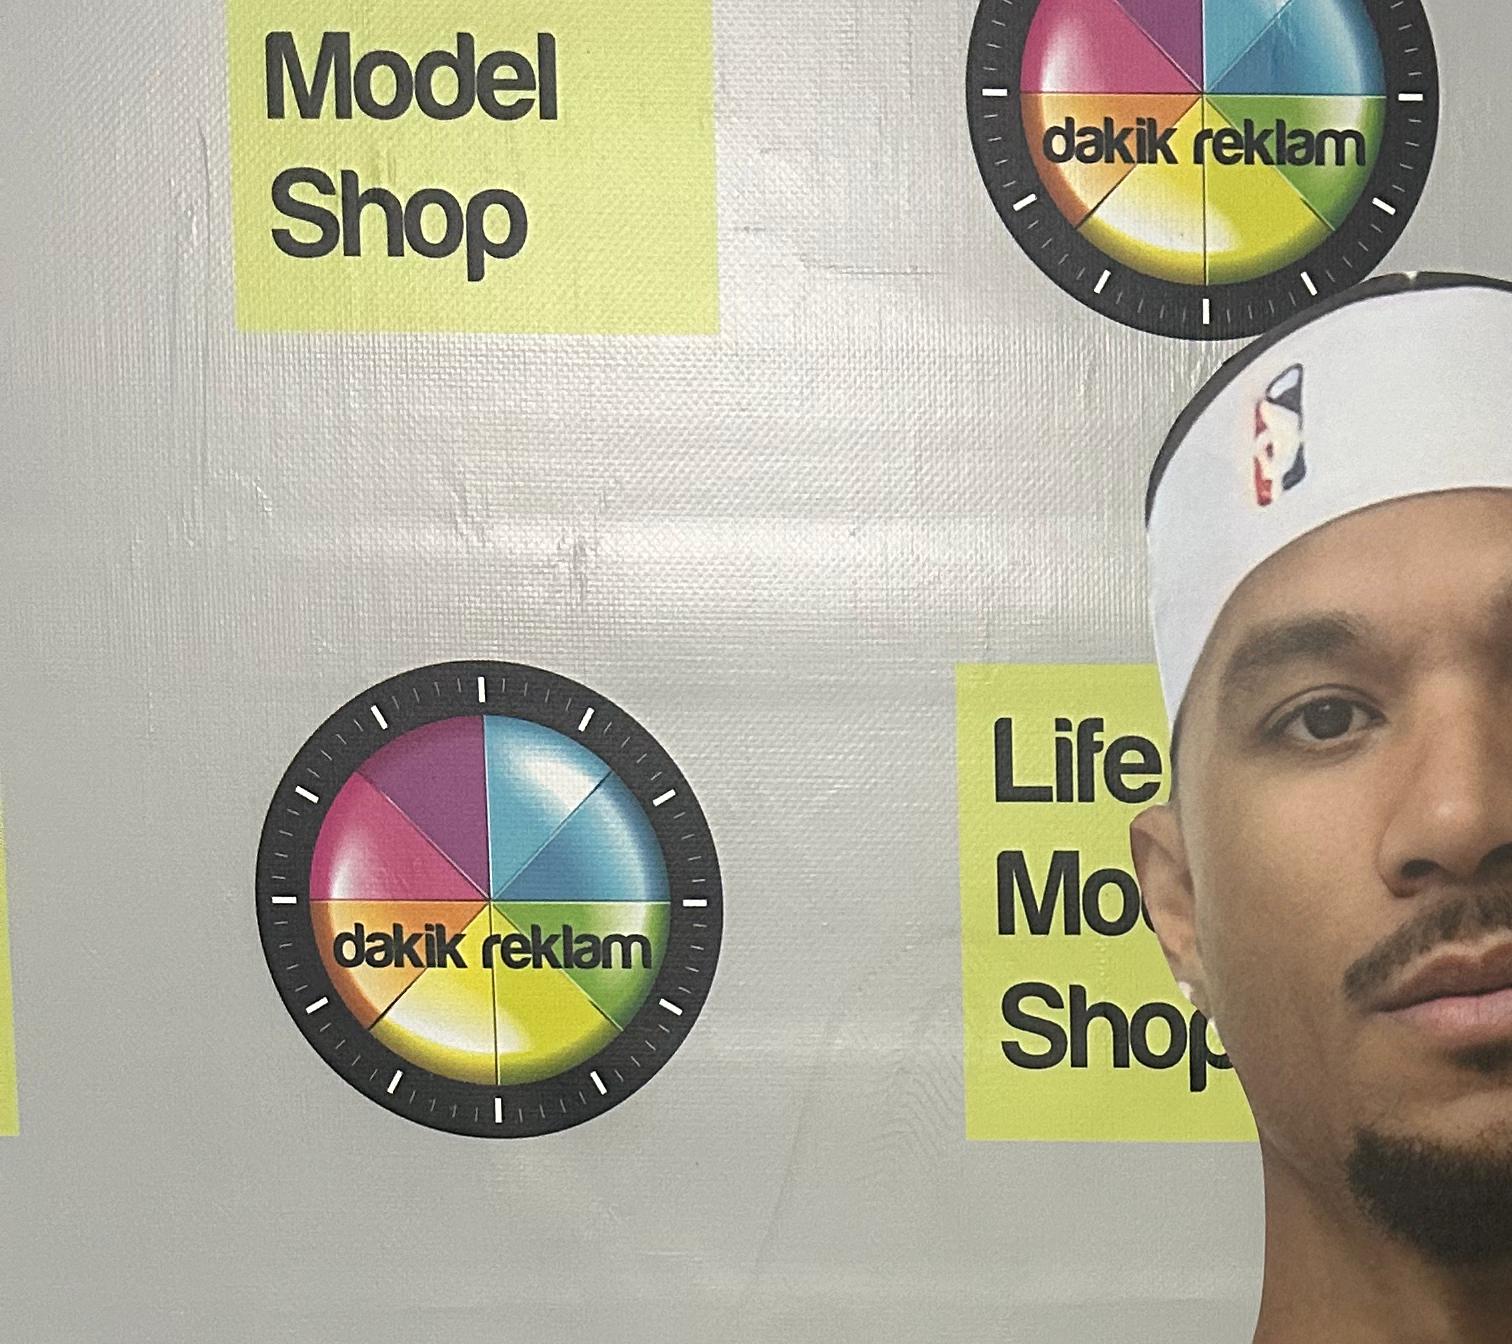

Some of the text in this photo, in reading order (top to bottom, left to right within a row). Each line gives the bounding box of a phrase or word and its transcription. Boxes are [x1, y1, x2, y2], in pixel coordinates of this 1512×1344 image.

[265, 31, 558, 121] Model
[1042, 116, 1366, 167] dakik reklam
[271, 167, 528, 281] Shop
[994, 717, 1163, 804] Life
[333, 922, 653, 970] dakik reklam
